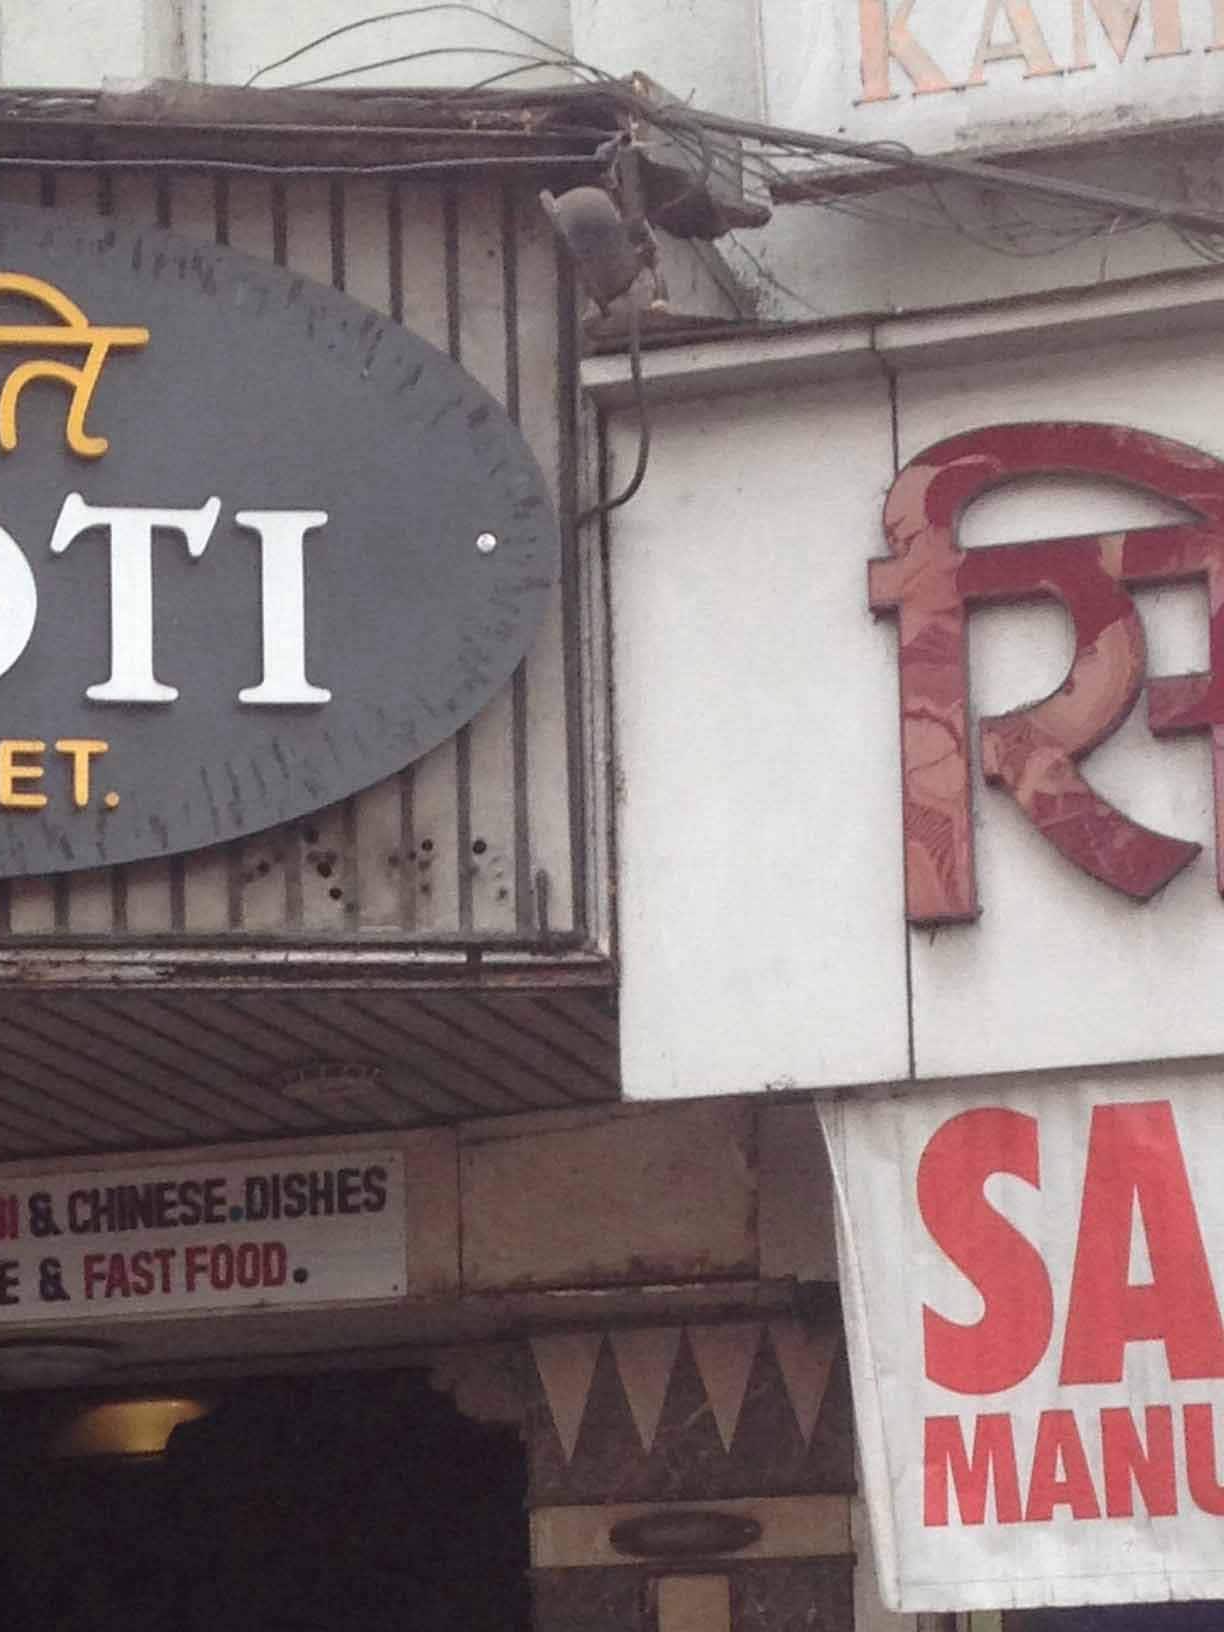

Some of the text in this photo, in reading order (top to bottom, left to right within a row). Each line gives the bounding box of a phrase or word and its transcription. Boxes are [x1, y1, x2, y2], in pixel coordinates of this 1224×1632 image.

[851, 0, 1224, 107] KAM
[28, 1192, 63, 1238] &
[916, 1099, 1224, 1396] SA
[39, 1257, 71, 1302] &
[83, 1247, 176, 1301] FAST
